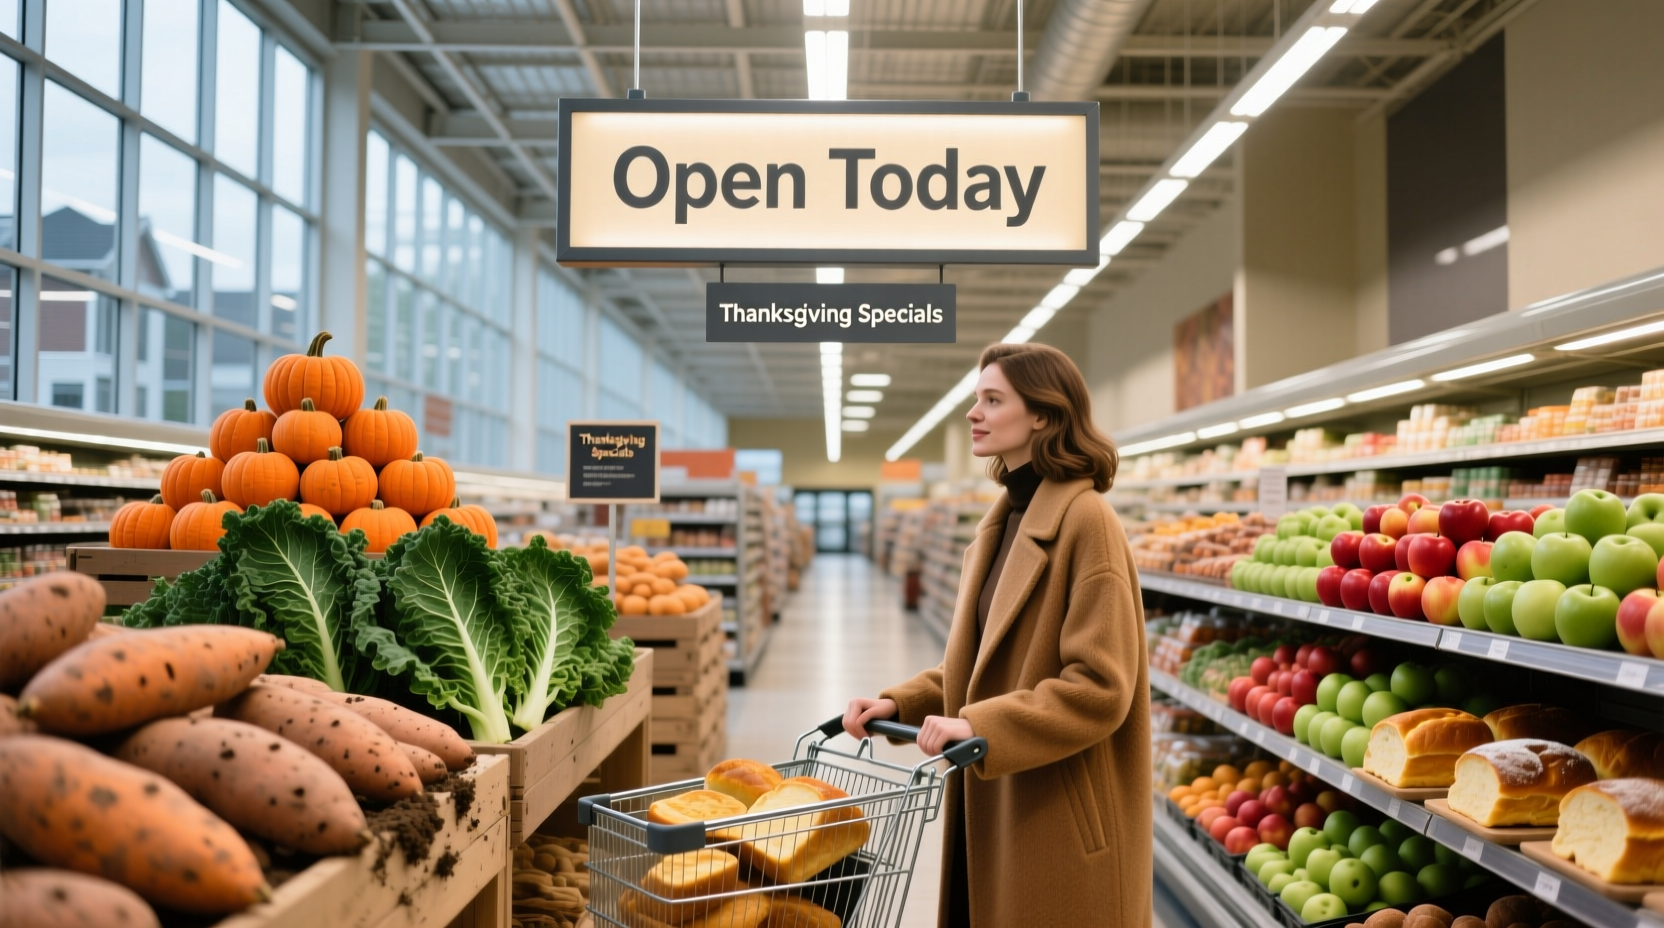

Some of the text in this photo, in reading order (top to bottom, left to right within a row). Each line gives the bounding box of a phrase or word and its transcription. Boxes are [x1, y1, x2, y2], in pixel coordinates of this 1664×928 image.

[613, 145, 1047, 228] Open Today
[858, 303, 944, 328] Specials
